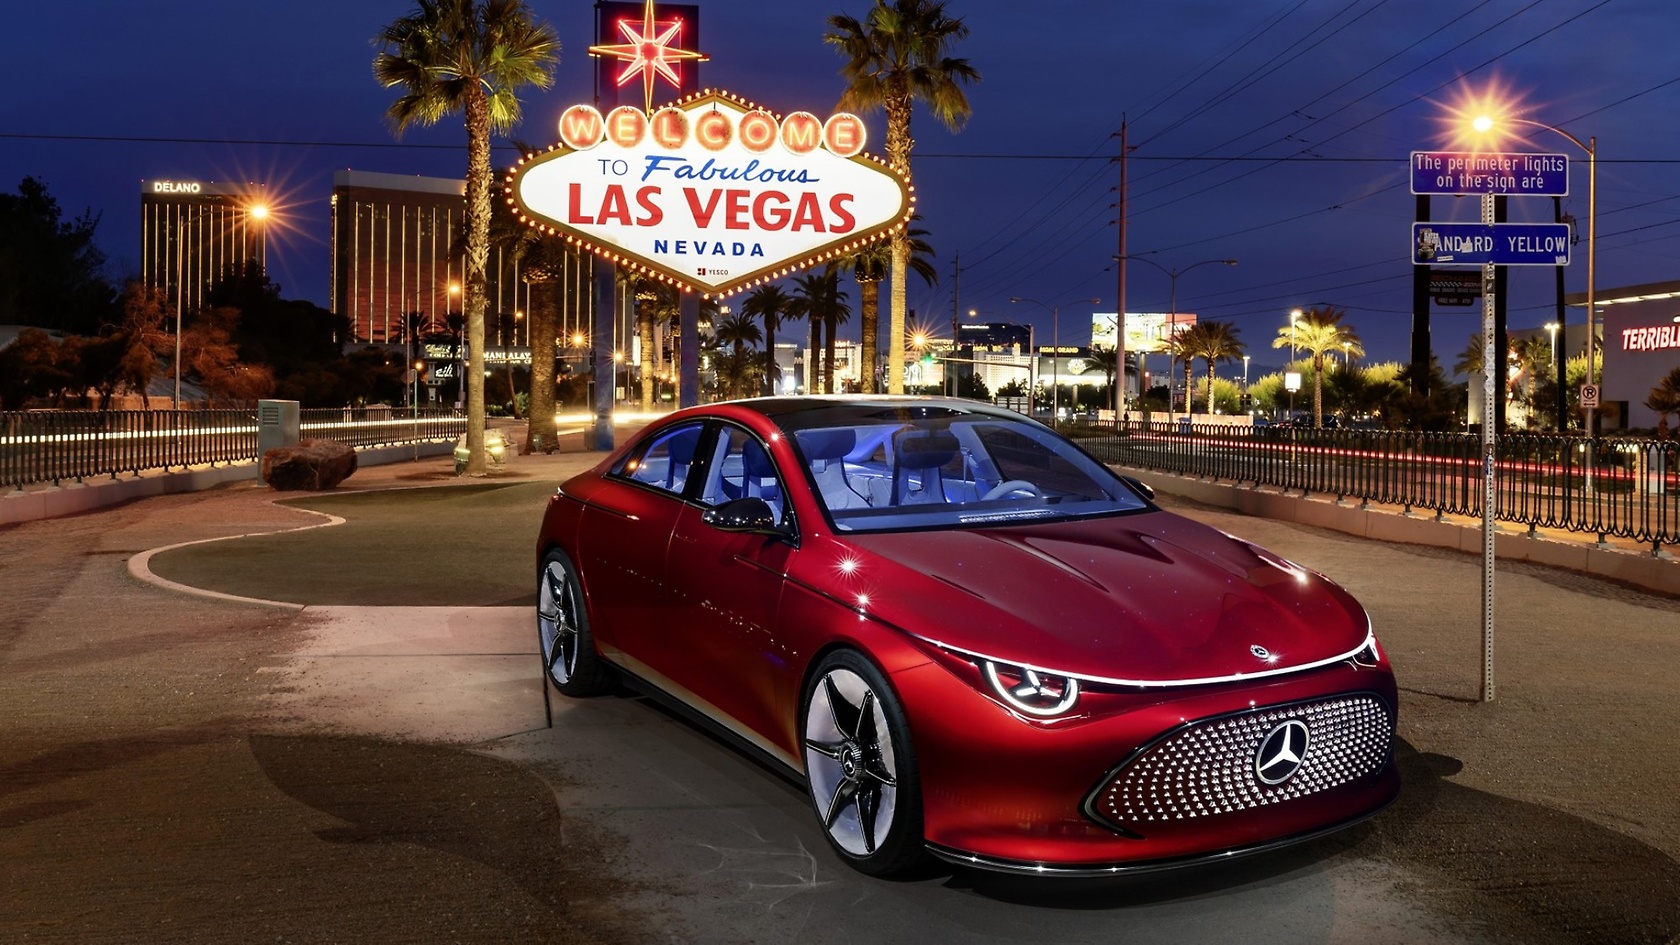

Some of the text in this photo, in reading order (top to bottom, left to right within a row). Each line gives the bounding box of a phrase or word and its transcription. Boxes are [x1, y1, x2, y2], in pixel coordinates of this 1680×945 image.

[566, 112, 857, 149] WELCOME
[598, 154, 820, 184] TO Fabulous
[1416, 154, 1564, 176] The perimeter lights
[154, 182, 201, 193] DELANO
[1436, 173, 1544, 193] on the sign are
[568, 182, 856, 234] LAS VEGAS
[653, 239, 765, 257] NEVADA
[1507, 236, 1566, 253] YELLOW
[708, 268, 729, 276] YESCO
